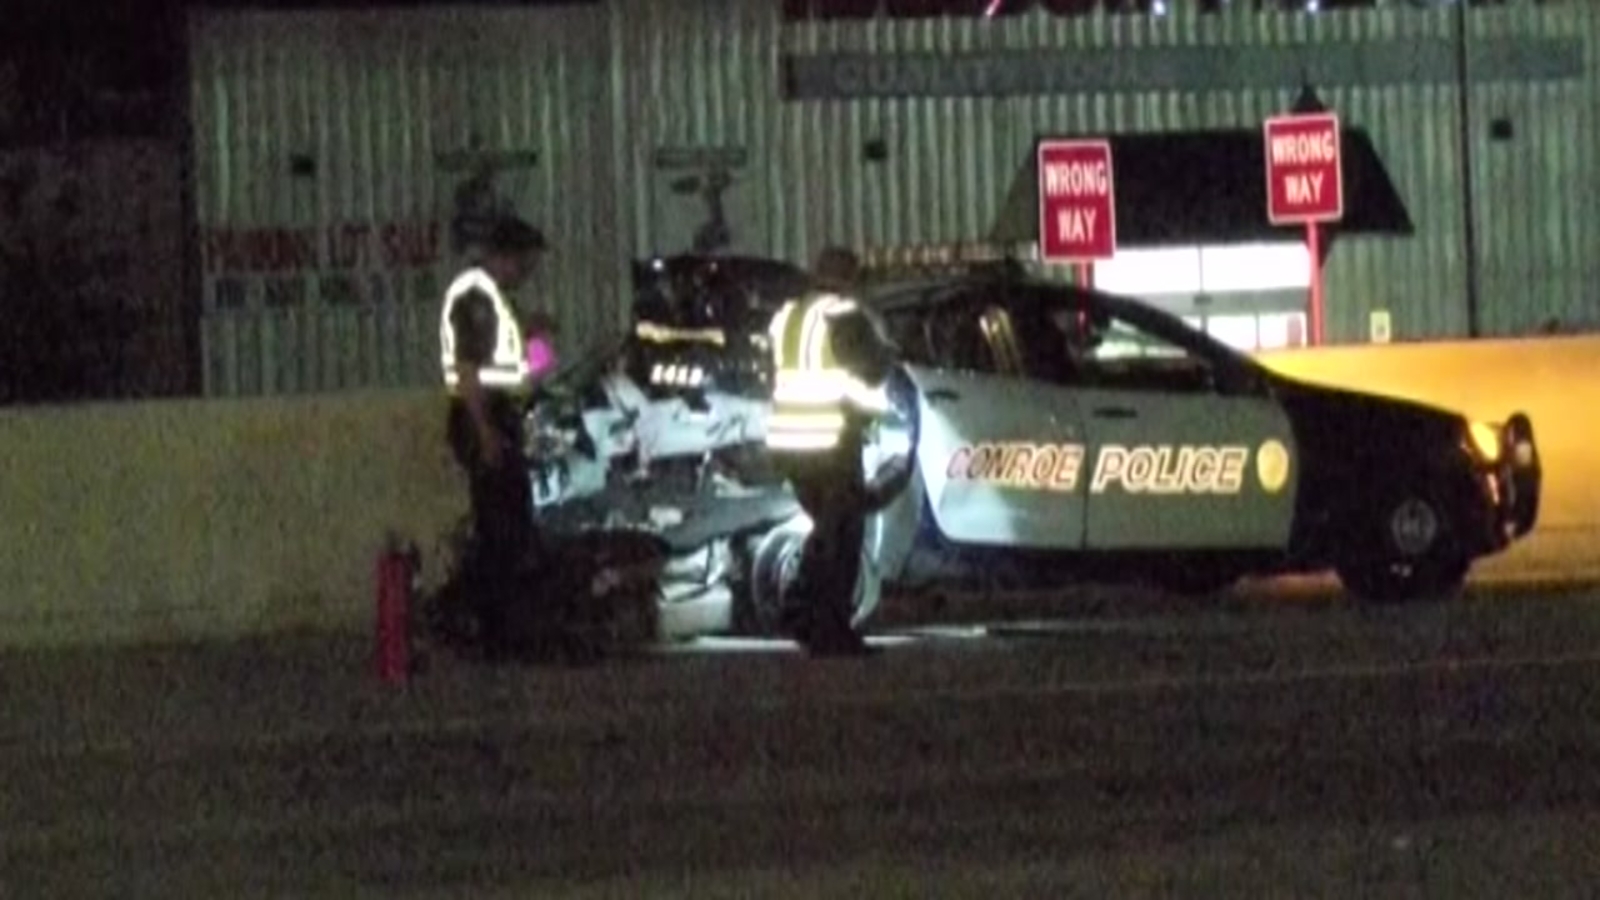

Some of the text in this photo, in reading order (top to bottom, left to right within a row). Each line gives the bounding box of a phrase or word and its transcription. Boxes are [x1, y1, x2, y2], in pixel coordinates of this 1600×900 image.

[1271, 132, 1335, 165] WRONG
[1044, 162, 1108, 198] WRONG
[1285, 172, 1324, 205] WAY
[1057, 208, 1097, 244] WAY
[946, 441, 1248, 494] CONROE POLICE
